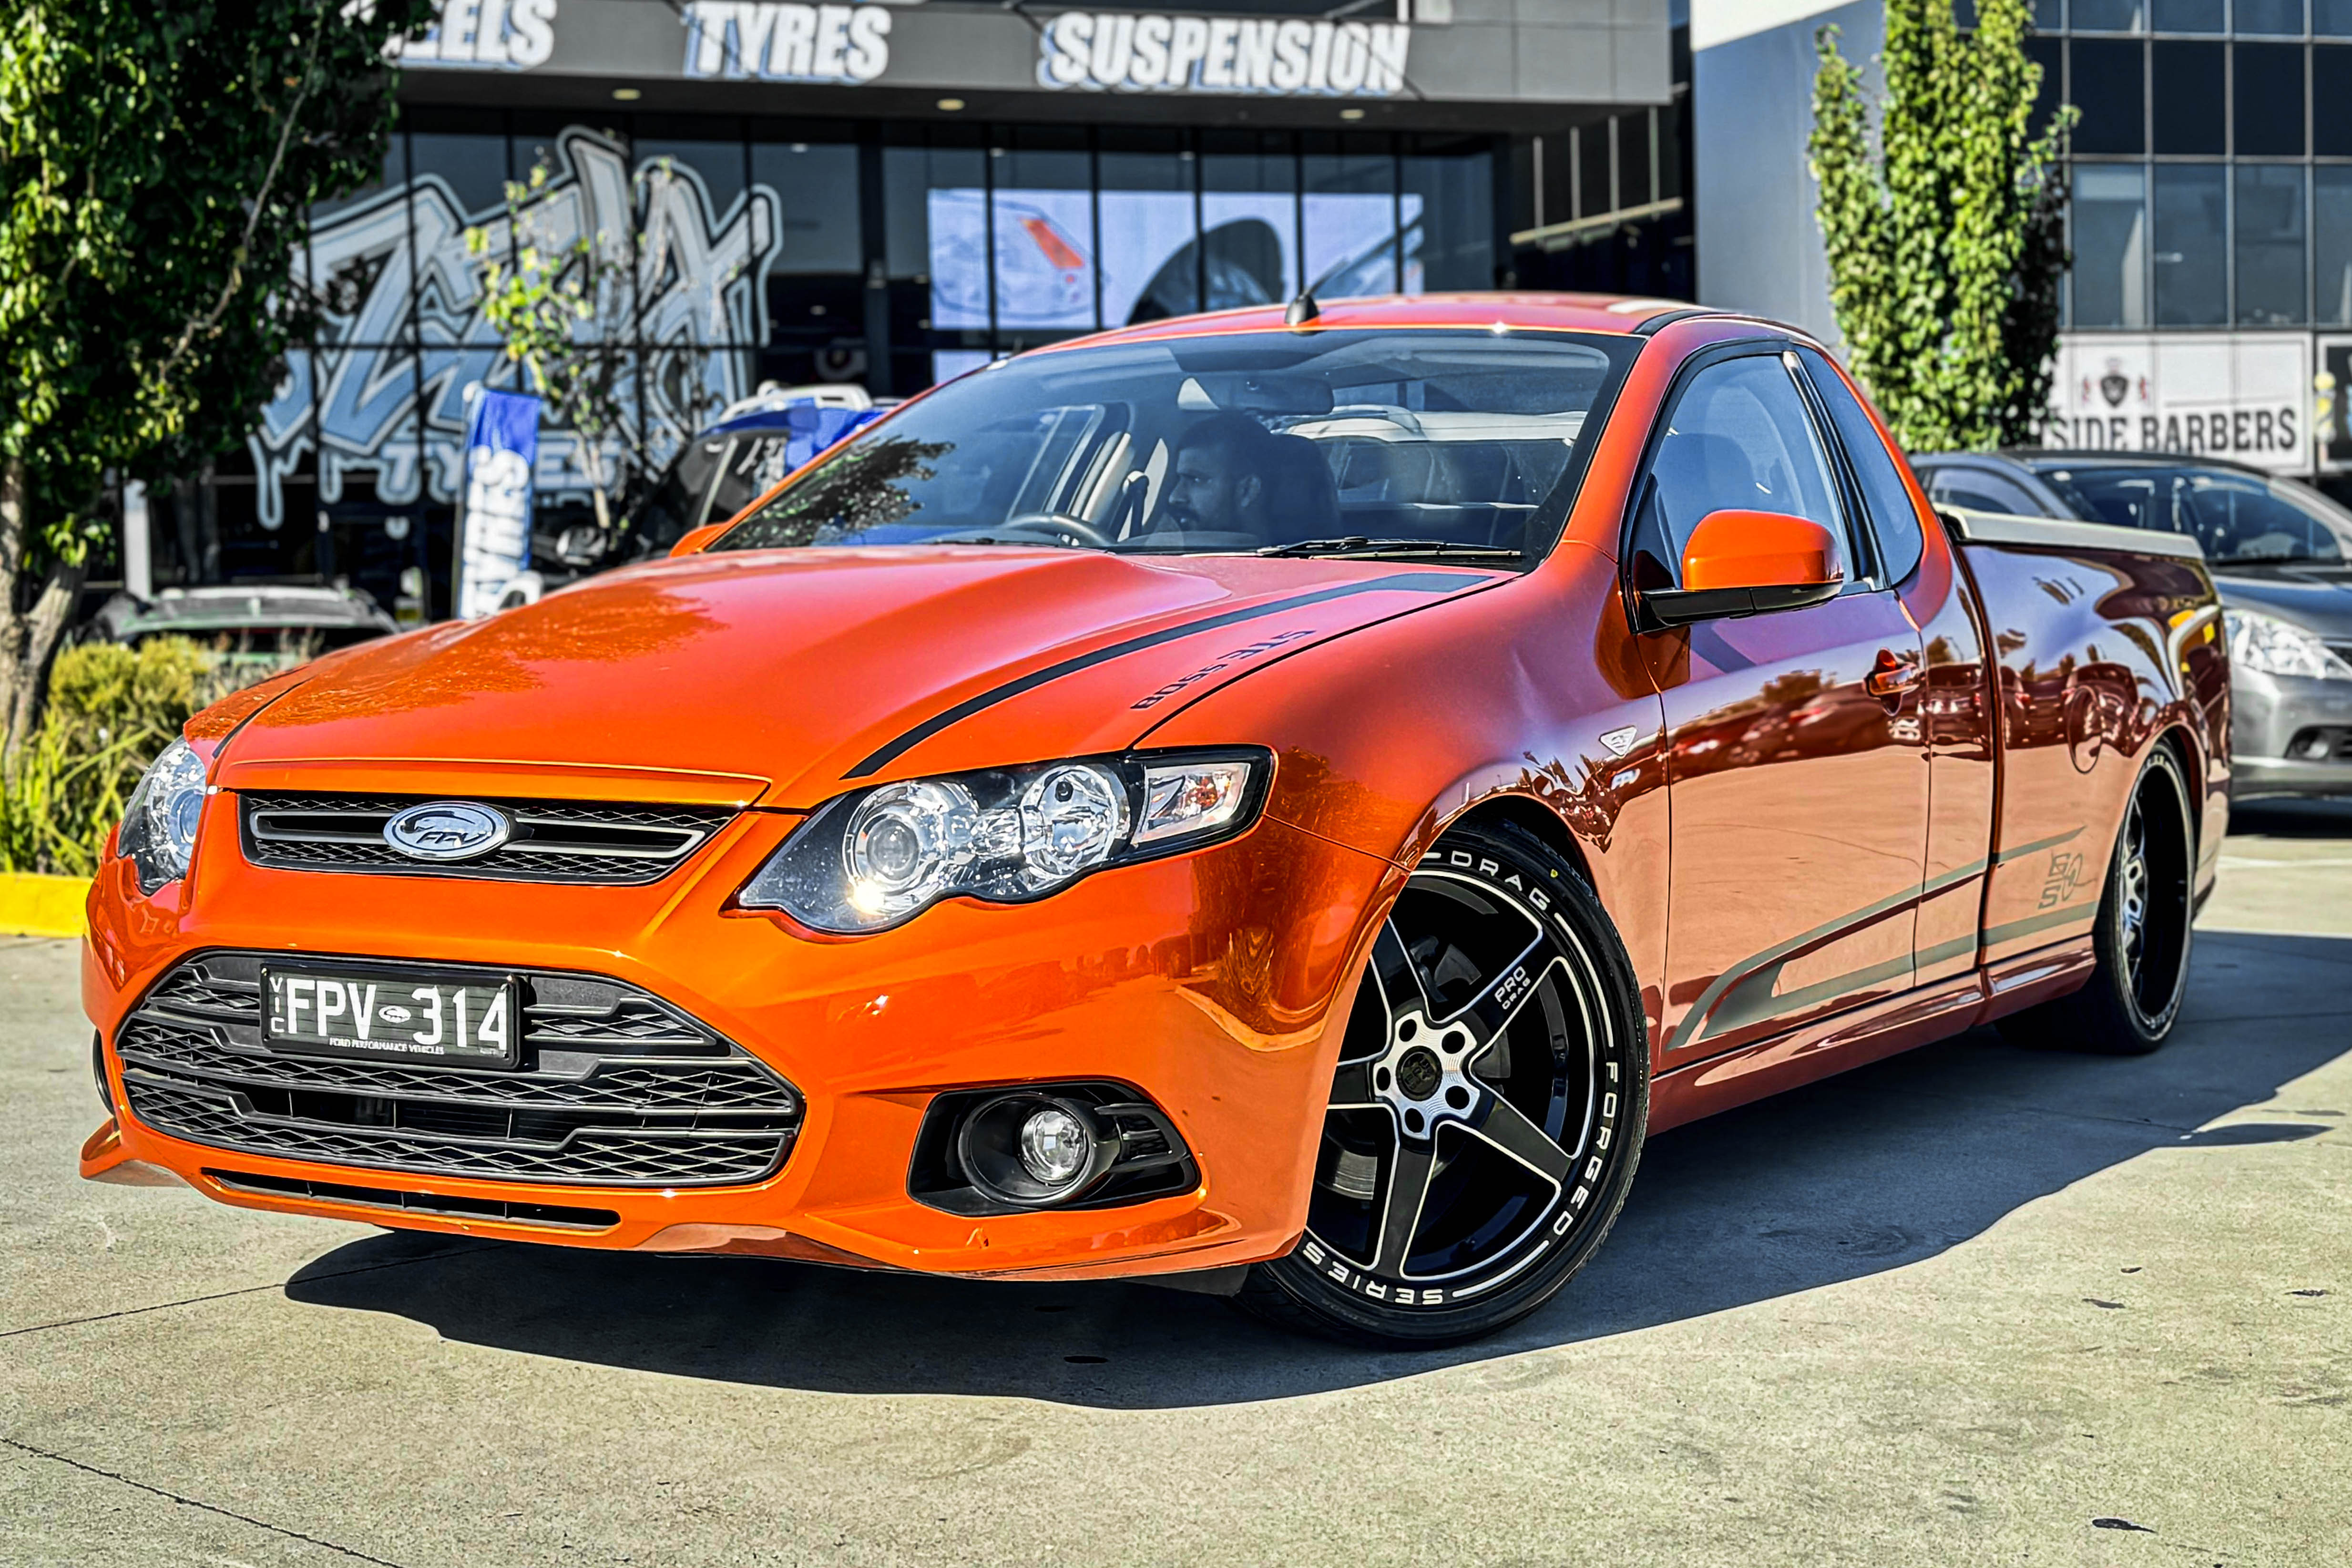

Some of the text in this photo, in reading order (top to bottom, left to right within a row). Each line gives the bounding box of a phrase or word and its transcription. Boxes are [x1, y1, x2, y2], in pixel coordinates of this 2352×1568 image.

[683, 1, 892, 86] TYRES
[1037, 10, 1411, 96] SUSPENSION
[2140, 407, 2298, 453] BARBERS
[1129, 663, 1228, 709] BOSS
[1450, 850, 1551, 911] DRAG
[269, 976, 286, 1033] VIC
[1494, 965, 1526, 1003] PRO
[1502, 977, 1531, 1010] DRAG
[286, 978, 508, 1051] FPV 314
[1553, 1061, 1619, 1236] FORGED
[1302, 1241, 1444, 1306] SERIES
